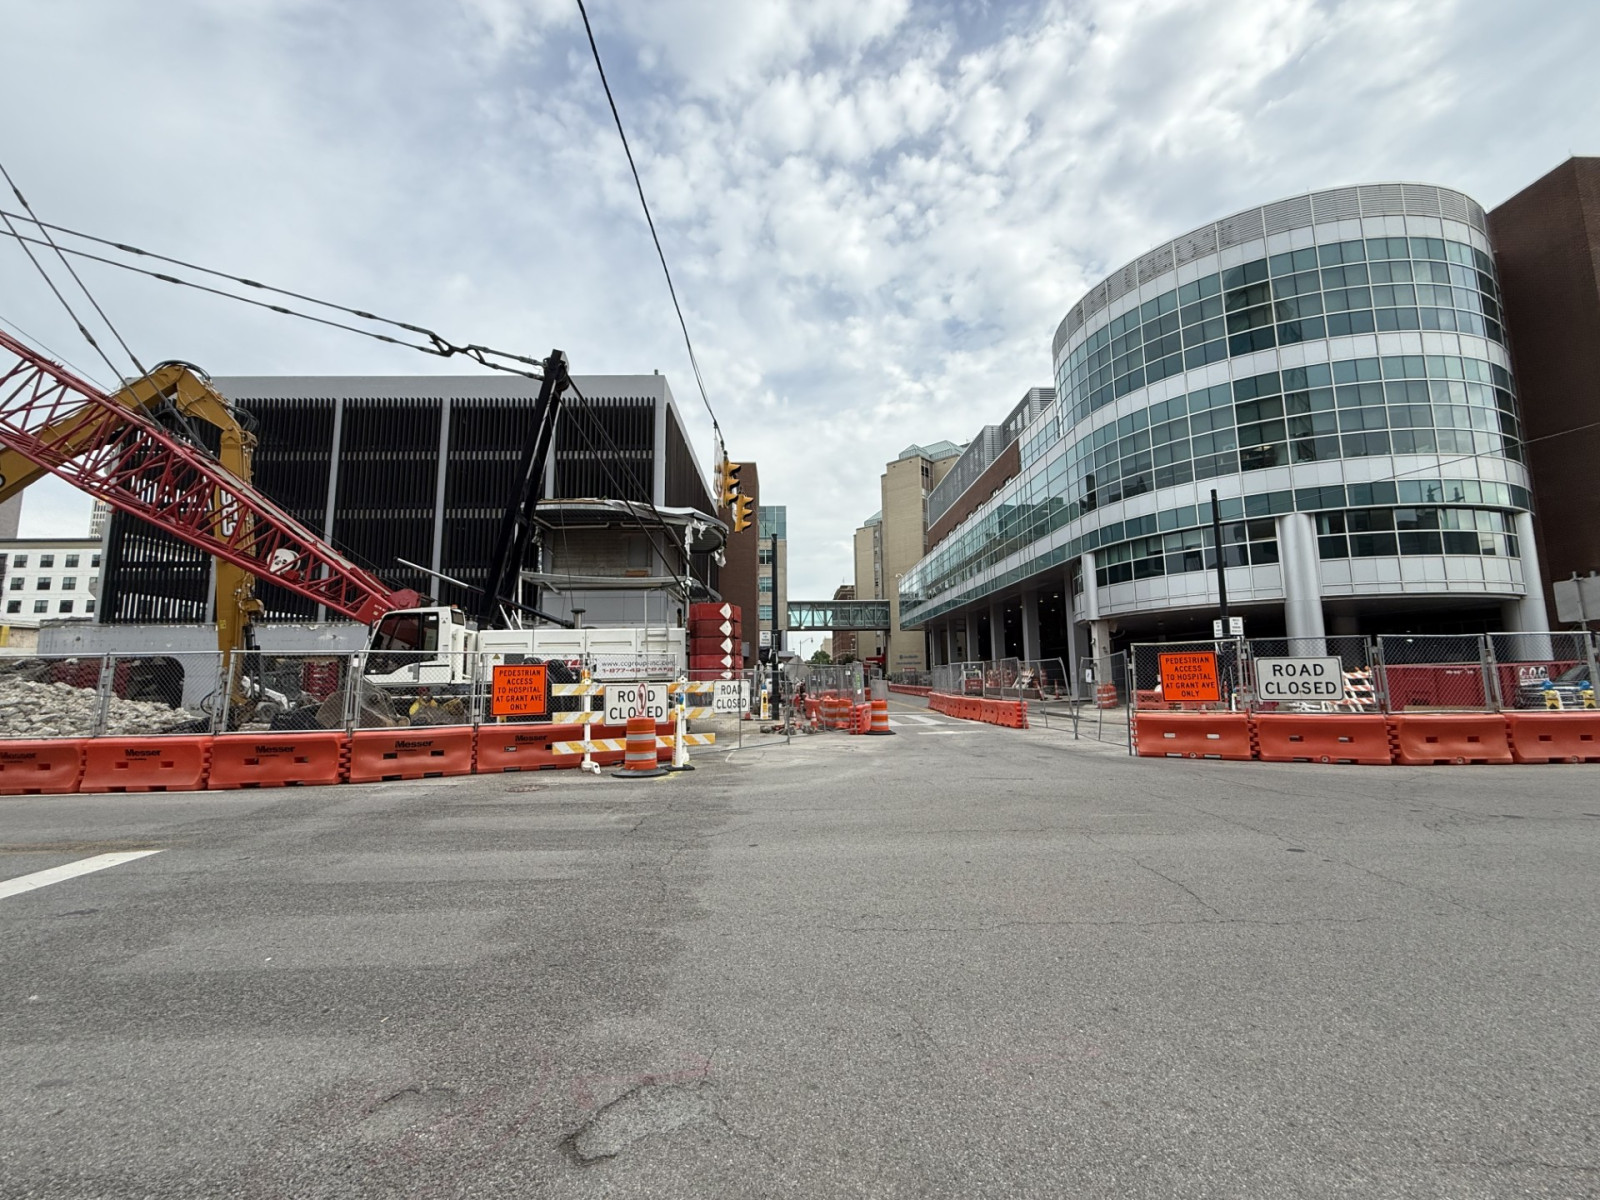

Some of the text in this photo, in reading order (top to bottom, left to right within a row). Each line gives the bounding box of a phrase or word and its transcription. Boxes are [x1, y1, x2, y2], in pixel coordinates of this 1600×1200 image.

[1165, 656, 1209, 664] PEDESTRIAN
[499, 669, 541, 677] PEDESTRIAN
[1272, 663, 1324, 677] ROAD
[506, 677, 533, 685] ACCESS
[1176, 681, 1200, 689] GRANT
[720, 684, 742, 695] ROAD
[1265, 681, 1337, 695] CLOSED
[529, 694, 543, 702] AVE
[617, 690, 656, 702] ROD
[1181, 689, 1200, 698] ONLY
[510, 703, 528, 711] ONLY
[609, 705, 663, 720] CLOED
[514, 734, 548, 742] Messer
[394, 739, 434, 748] Messer
[124, 748, 162, 757] Messer
[255, 745, 296, 754] Messer
